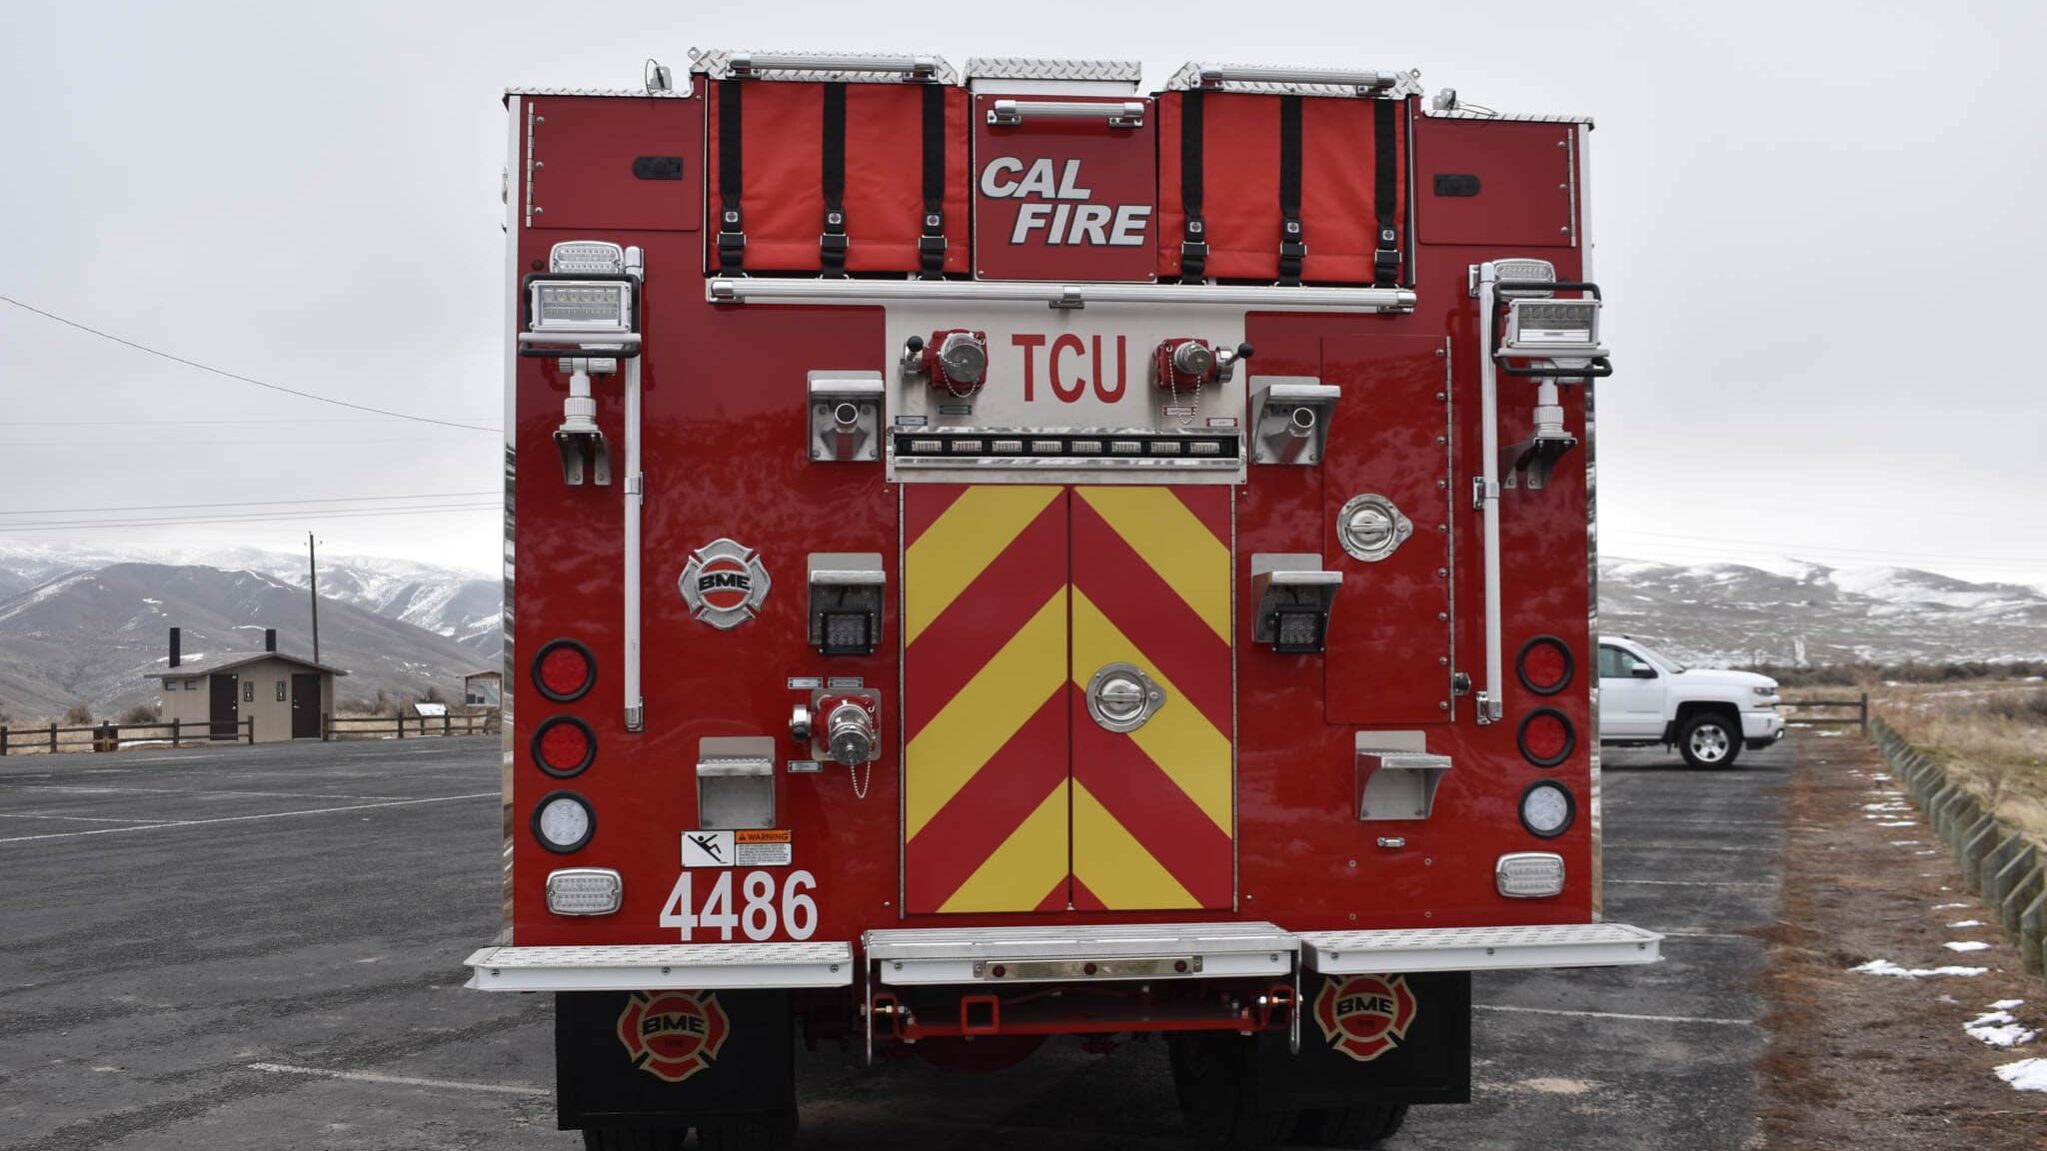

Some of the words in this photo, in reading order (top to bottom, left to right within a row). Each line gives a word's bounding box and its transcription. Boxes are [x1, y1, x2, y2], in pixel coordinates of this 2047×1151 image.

[980, 156, 1092, 200] CAL
[1010, 203, 1153, 245] FIRE
[1011, 333, 1127, 403] TCU
[698, 573, 751, 592] BME
[747, 832, 789, 841] WARNING
[659, 870, 818, 941] 4486
[1337, 996, 1393, 1016] BME
[643, 1014, 705, 1035] BME
